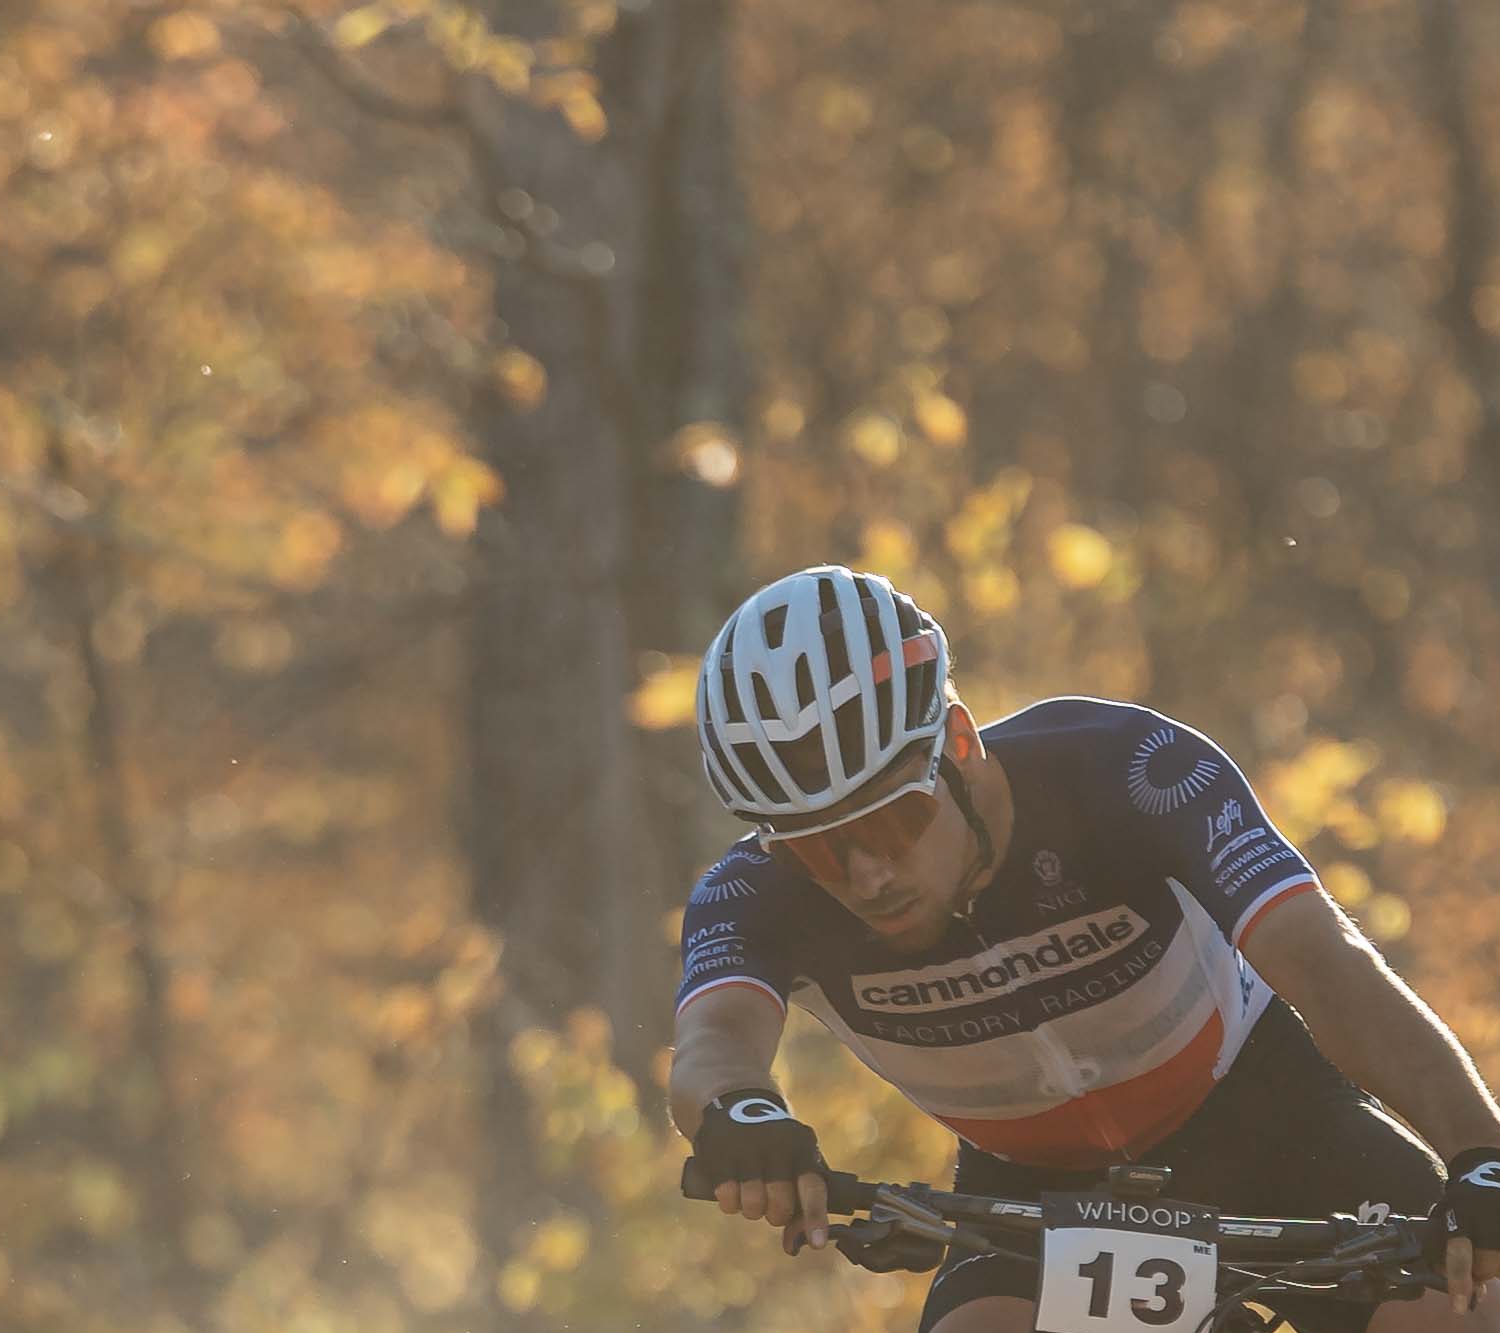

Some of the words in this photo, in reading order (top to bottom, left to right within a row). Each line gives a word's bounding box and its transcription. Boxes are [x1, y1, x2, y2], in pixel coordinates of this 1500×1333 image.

[1216, 842, 1272, 887] SCHWALBE
[1224, 849, 1297, 896] SHIMANO
[861, 920, 1135, 1006] cannondale
[874, 1010, 1024, 1043] FACTORY
[1039, 940, 1163, 1014] RACING
[1077, 1201, 1192, 1229] WHOOP
[1078, 1251, 1187, 1326] 13
